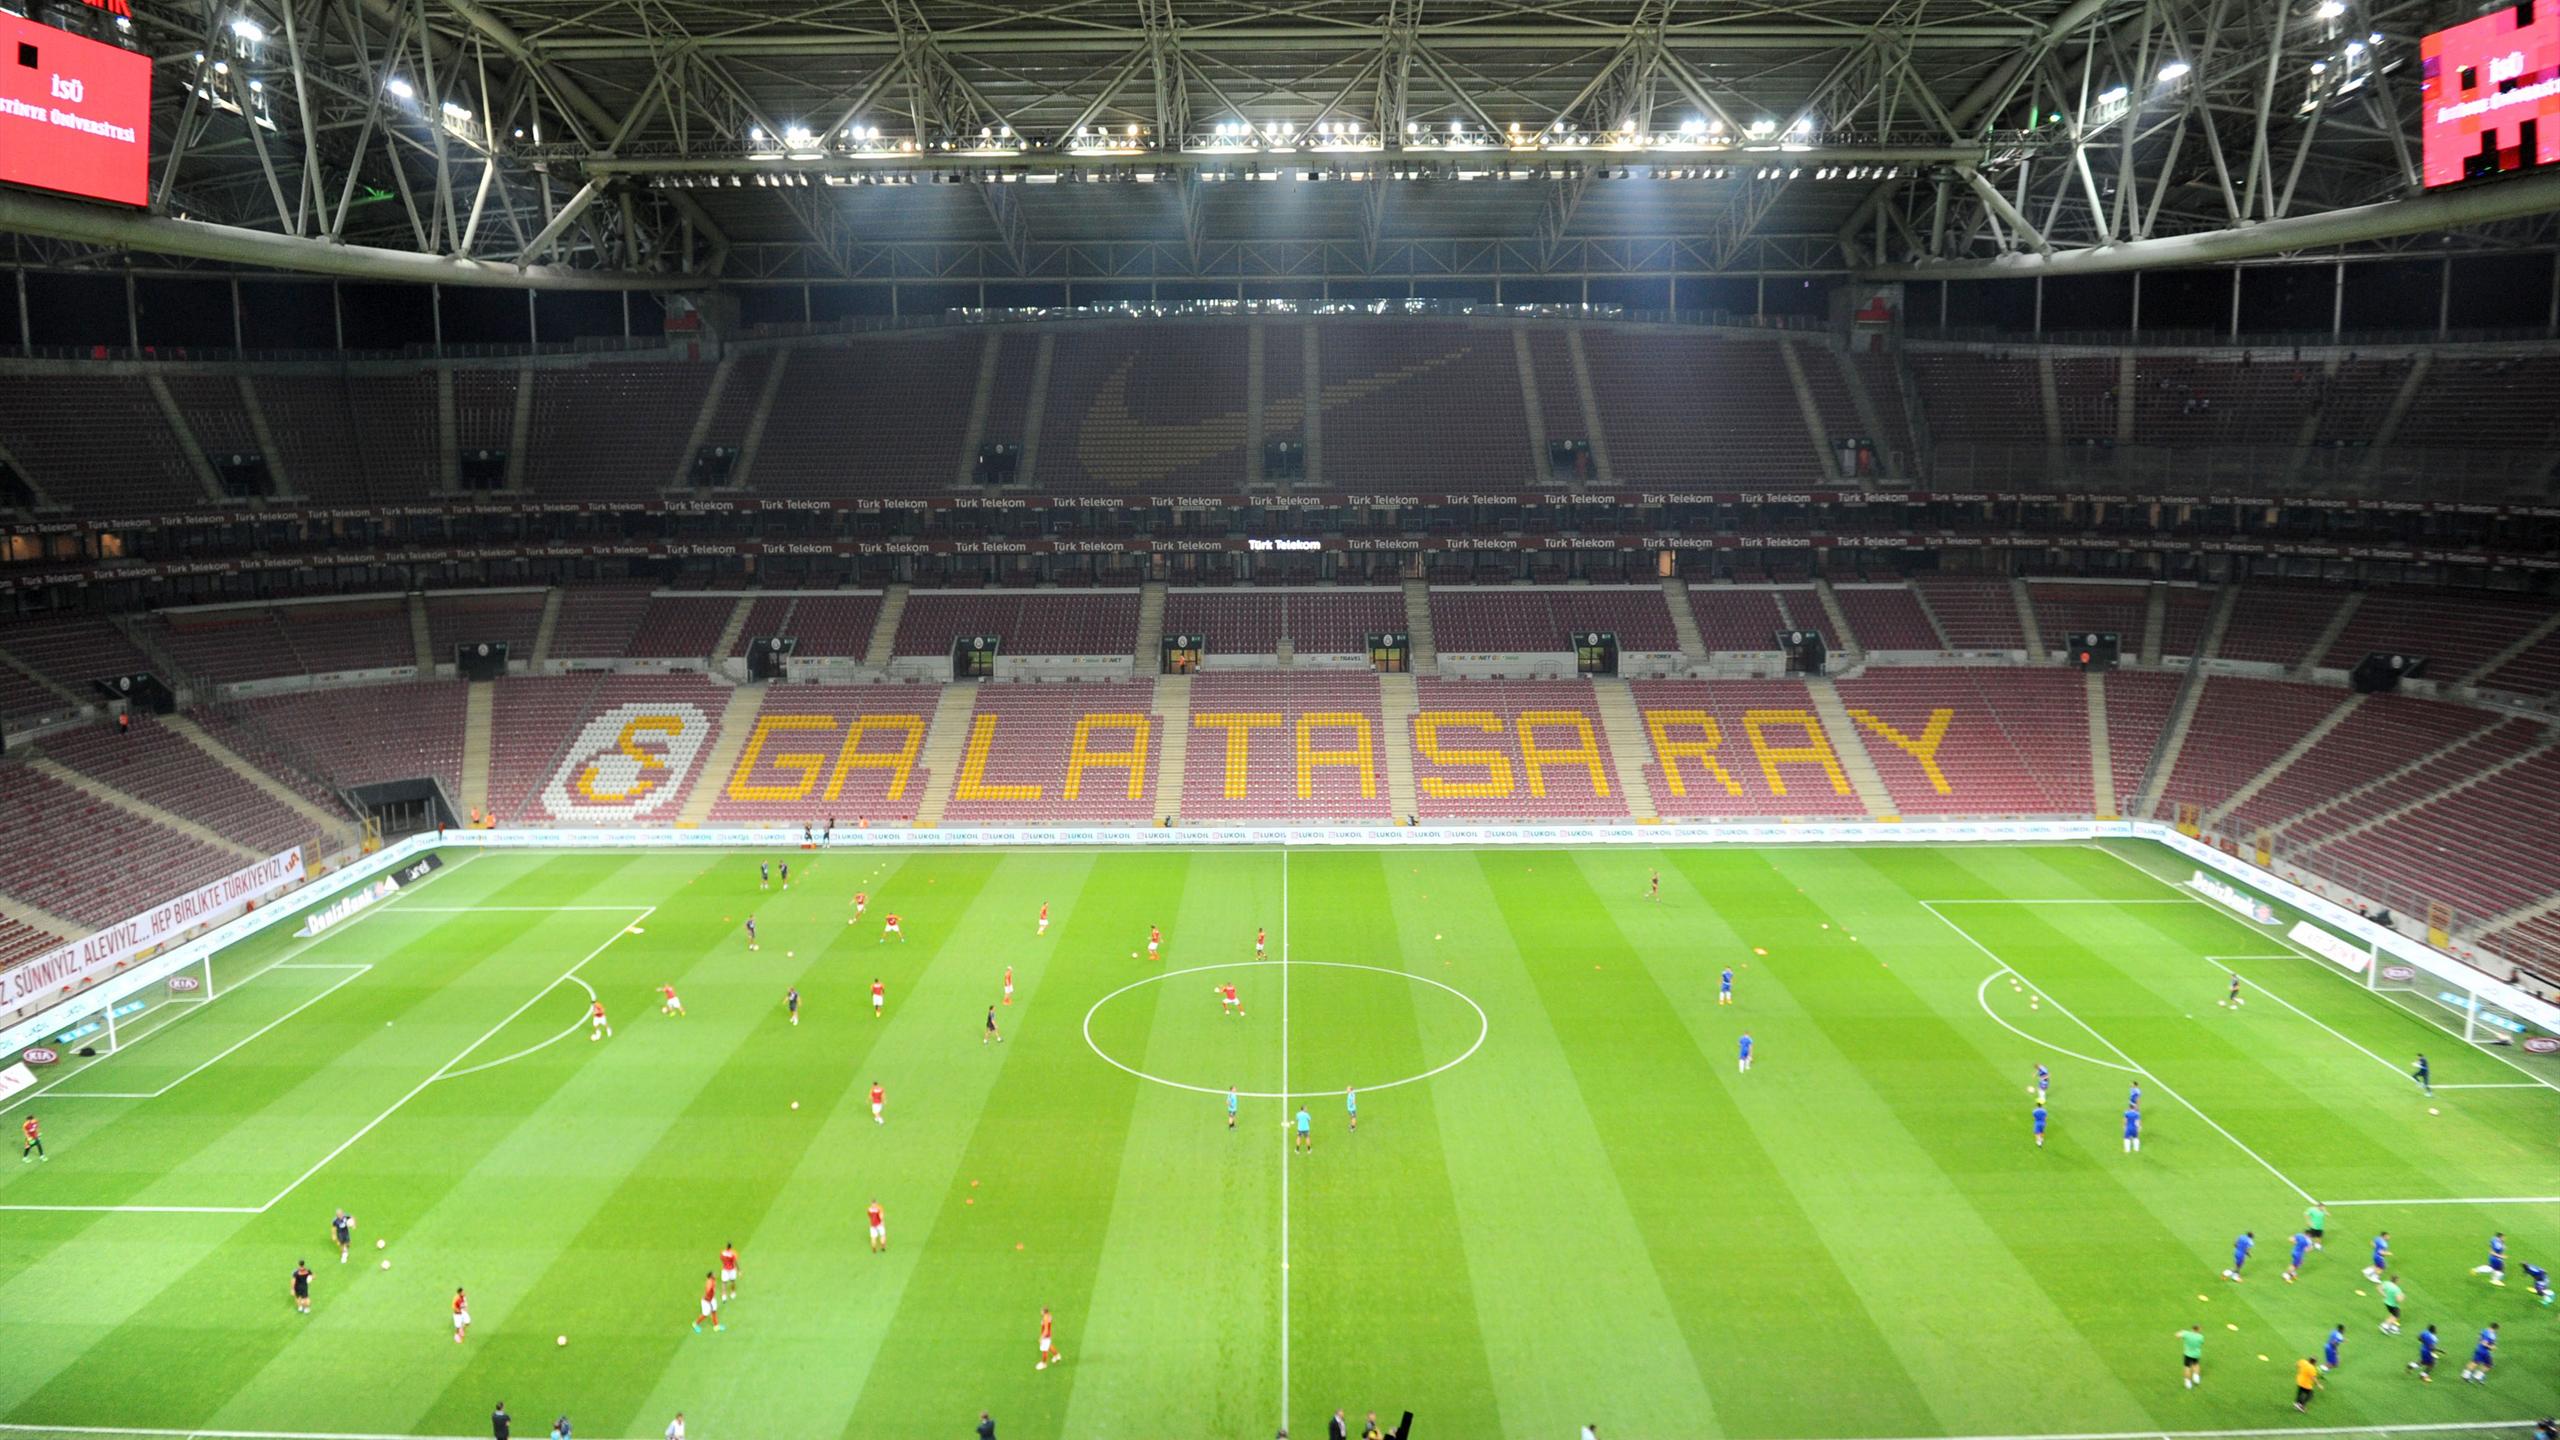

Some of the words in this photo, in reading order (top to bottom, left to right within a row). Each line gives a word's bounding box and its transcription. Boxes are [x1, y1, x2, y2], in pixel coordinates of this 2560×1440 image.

[1053, 497, 1077, 507] Türk
[1079, 497, 1123, 507] Telekom
[1151, 496, 1175, 506] Türk
[1177, 496, 1222, 506] Telekom
[1250, 496, 1273, 506] Türk
[1276, 496, 1320, 505] Telekom
[1348, 495, 1372, 505] Türk
[1374, 495, 1418, 505] Telekom
[1446, 495, 1470, 504] Türk
[1472, 494, 1516, 504] Telekom
[1544, 494, 1568, 504] Türk
[1570, 494, 1614, 504] Telekom
[1642, 494, 1666, 504] Türk
[1668, 494, 1712, 504] Telekom
[1740, 494, 1764, 504] Türk
[1766, 494, 1810, 503] Telekom
[1838, 493, 1862, 502] Türk
[1864, 493, 1908, 502] Telekom
[664, 501, 688, 511] Türk
[690, 500, 734, 511] Telekom
[760, 499, 784, 510] Türk
[786, 499, 830, 509] Telekom
[858, 498, 881, 508] Türk
[883, 498, 928, 508] Telekom
[954, 498, 978, 508] Türk
[981, 498, 1025, 508] Telekom
[1054, 542, 1077, 551] Türk
[1079, 542, 1124, 551] Telekom
[1151, 541, 1175, 550] Türk
[1177, 540, 1222, 550] Telekom
[1248, 540, 1273, 550] Türk
[1275, 540, 1320, 550] Telekom
[1348, 540, 1372, 550] Türk
[1374, 540, 1418, 549] Telekom
[1446, 539, 1470, 549] Türk
[1472, 539, 1516, 549] Telekom
[1544, 538, 1568, 548] Türk
[1570, 538, 1614, 548] Telekom
[1642, 538, 1666, 548] Türk
[1668, 538, 1712, 548] Telekom
[1740, 538, 1764, 548] Türk
[1766, 538, 1810, 547] Telekom
[1837, 537, 1861, 546] Türk
[1863, 537, 1907, 546] Telekom
[666, 545, 690, 554] Türk
[692, 544, 736, 554] Telekom
[762, 544, 786, 554] Türk
[788, 543, 832, 553] Telekom
[860, 543, 883, 552] Türk
[885, 542, 928, 552] Telekom
[956, 542, 980, 552] Türk
[982, 542, 1026, 551] Telekom
[728, 709, 1954, 801] GALATASARAY
[151, 908, 173, 937] HEP
[174, 885, 223, 920] BİRLİKTE
[172, 978, 195, 987] KIA
[29, 1050, 52, 1060] KIA
